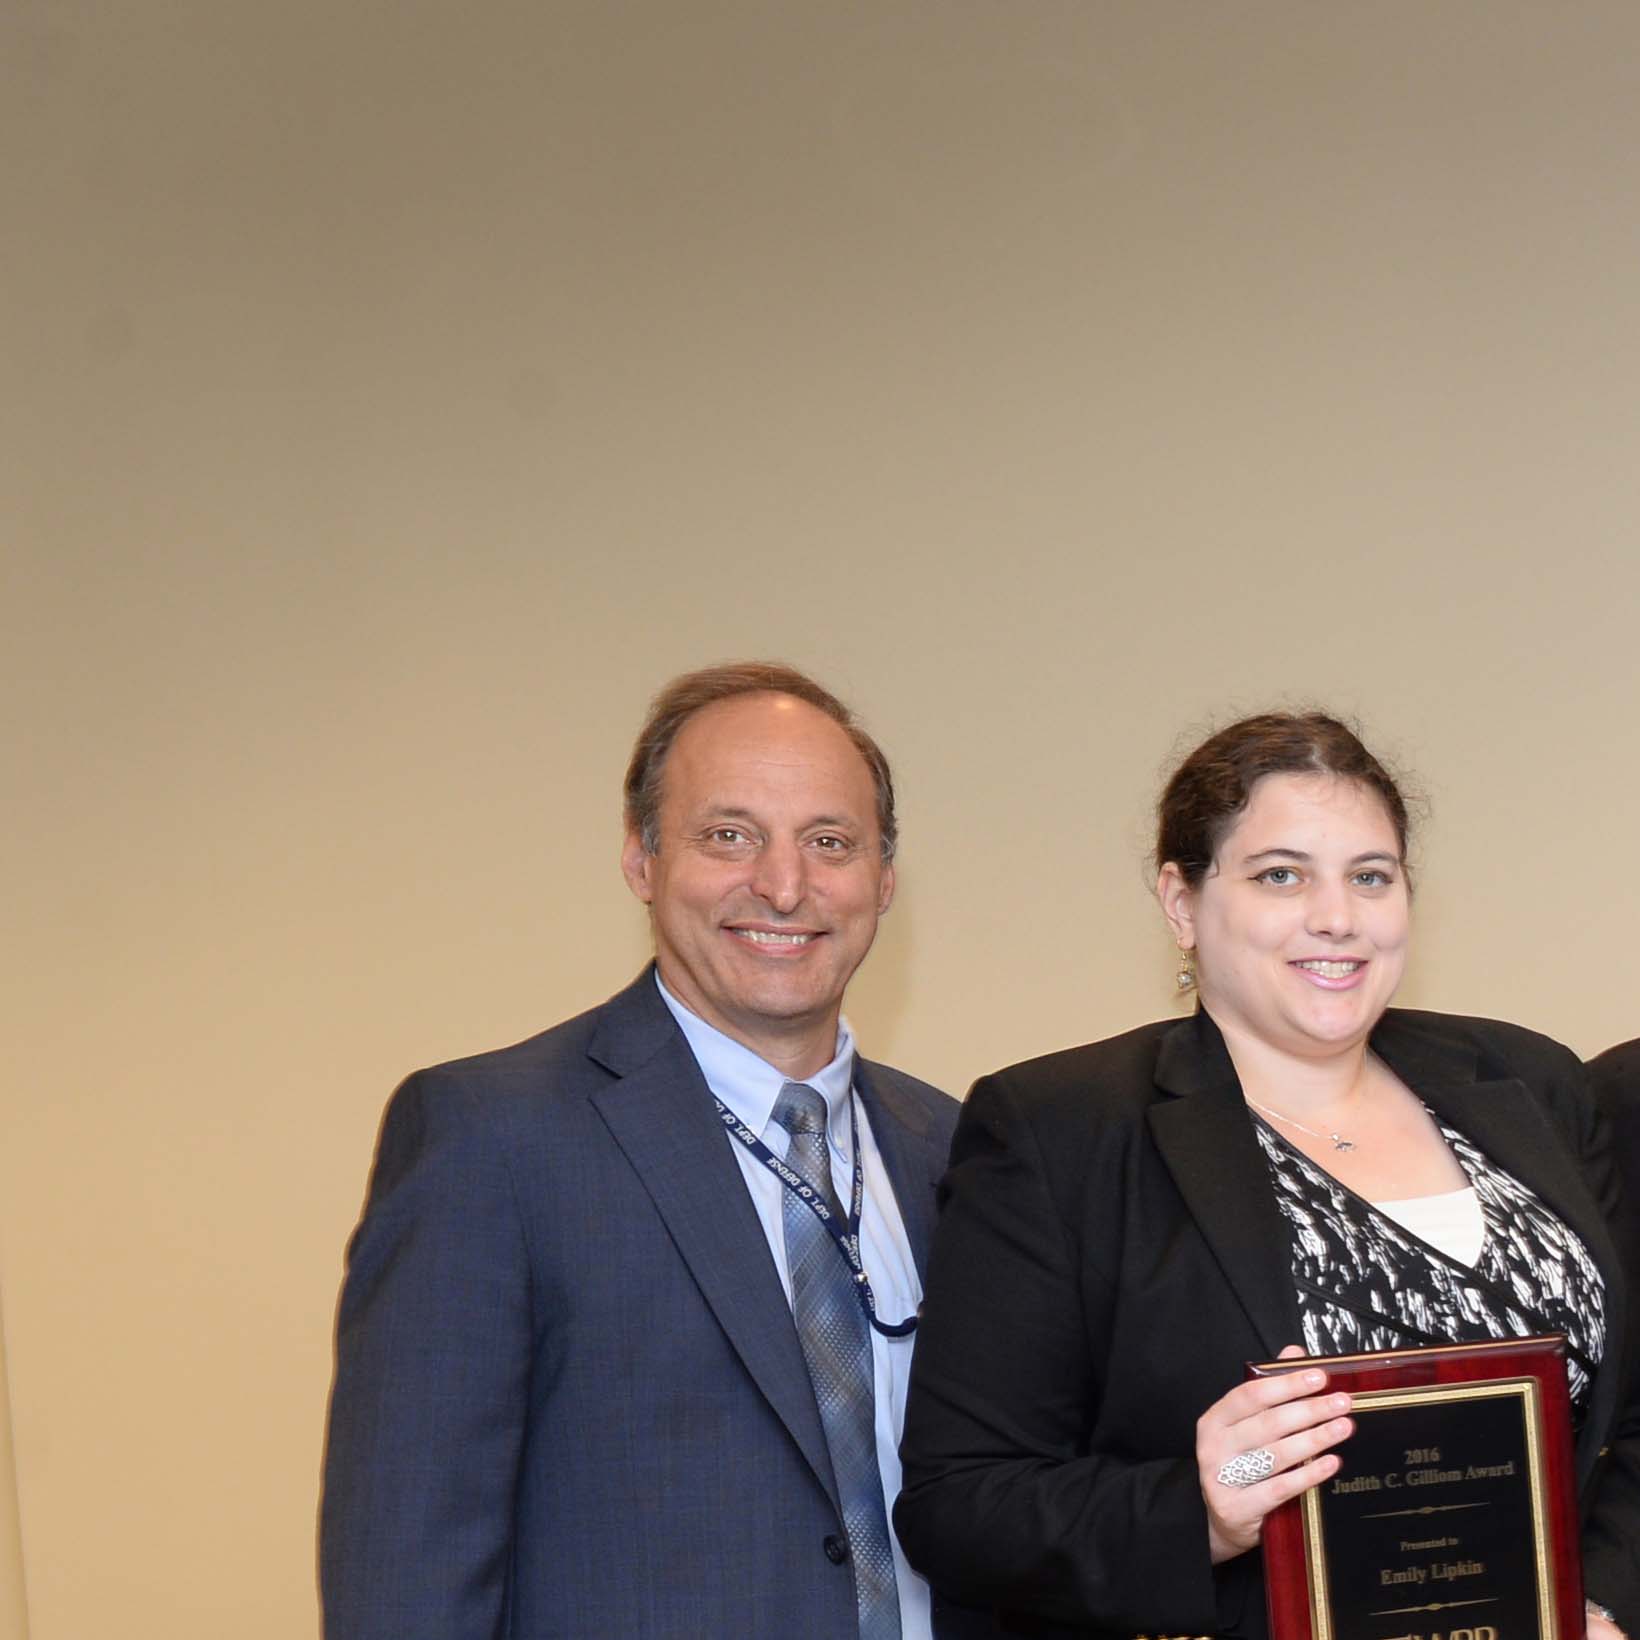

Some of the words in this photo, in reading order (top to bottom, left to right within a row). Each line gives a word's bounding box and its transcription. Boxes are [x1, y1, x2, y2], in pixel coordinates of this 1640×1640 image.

[767, 1157, 801, 1186] DEFENSE
[1404, 1448, 1441, 1465] 2016
[1331, 1476, 1381, 1496] Judith
[1385, 1473, 1402, 1489] C.
[1407, 1466, 1461, 1487] Gilliom
[1466, 1461, 1515, 1479] Award
[1380, 1567, 1426, 1587] Emily
[1431, 1560, 1484, 1582] Lipkin
